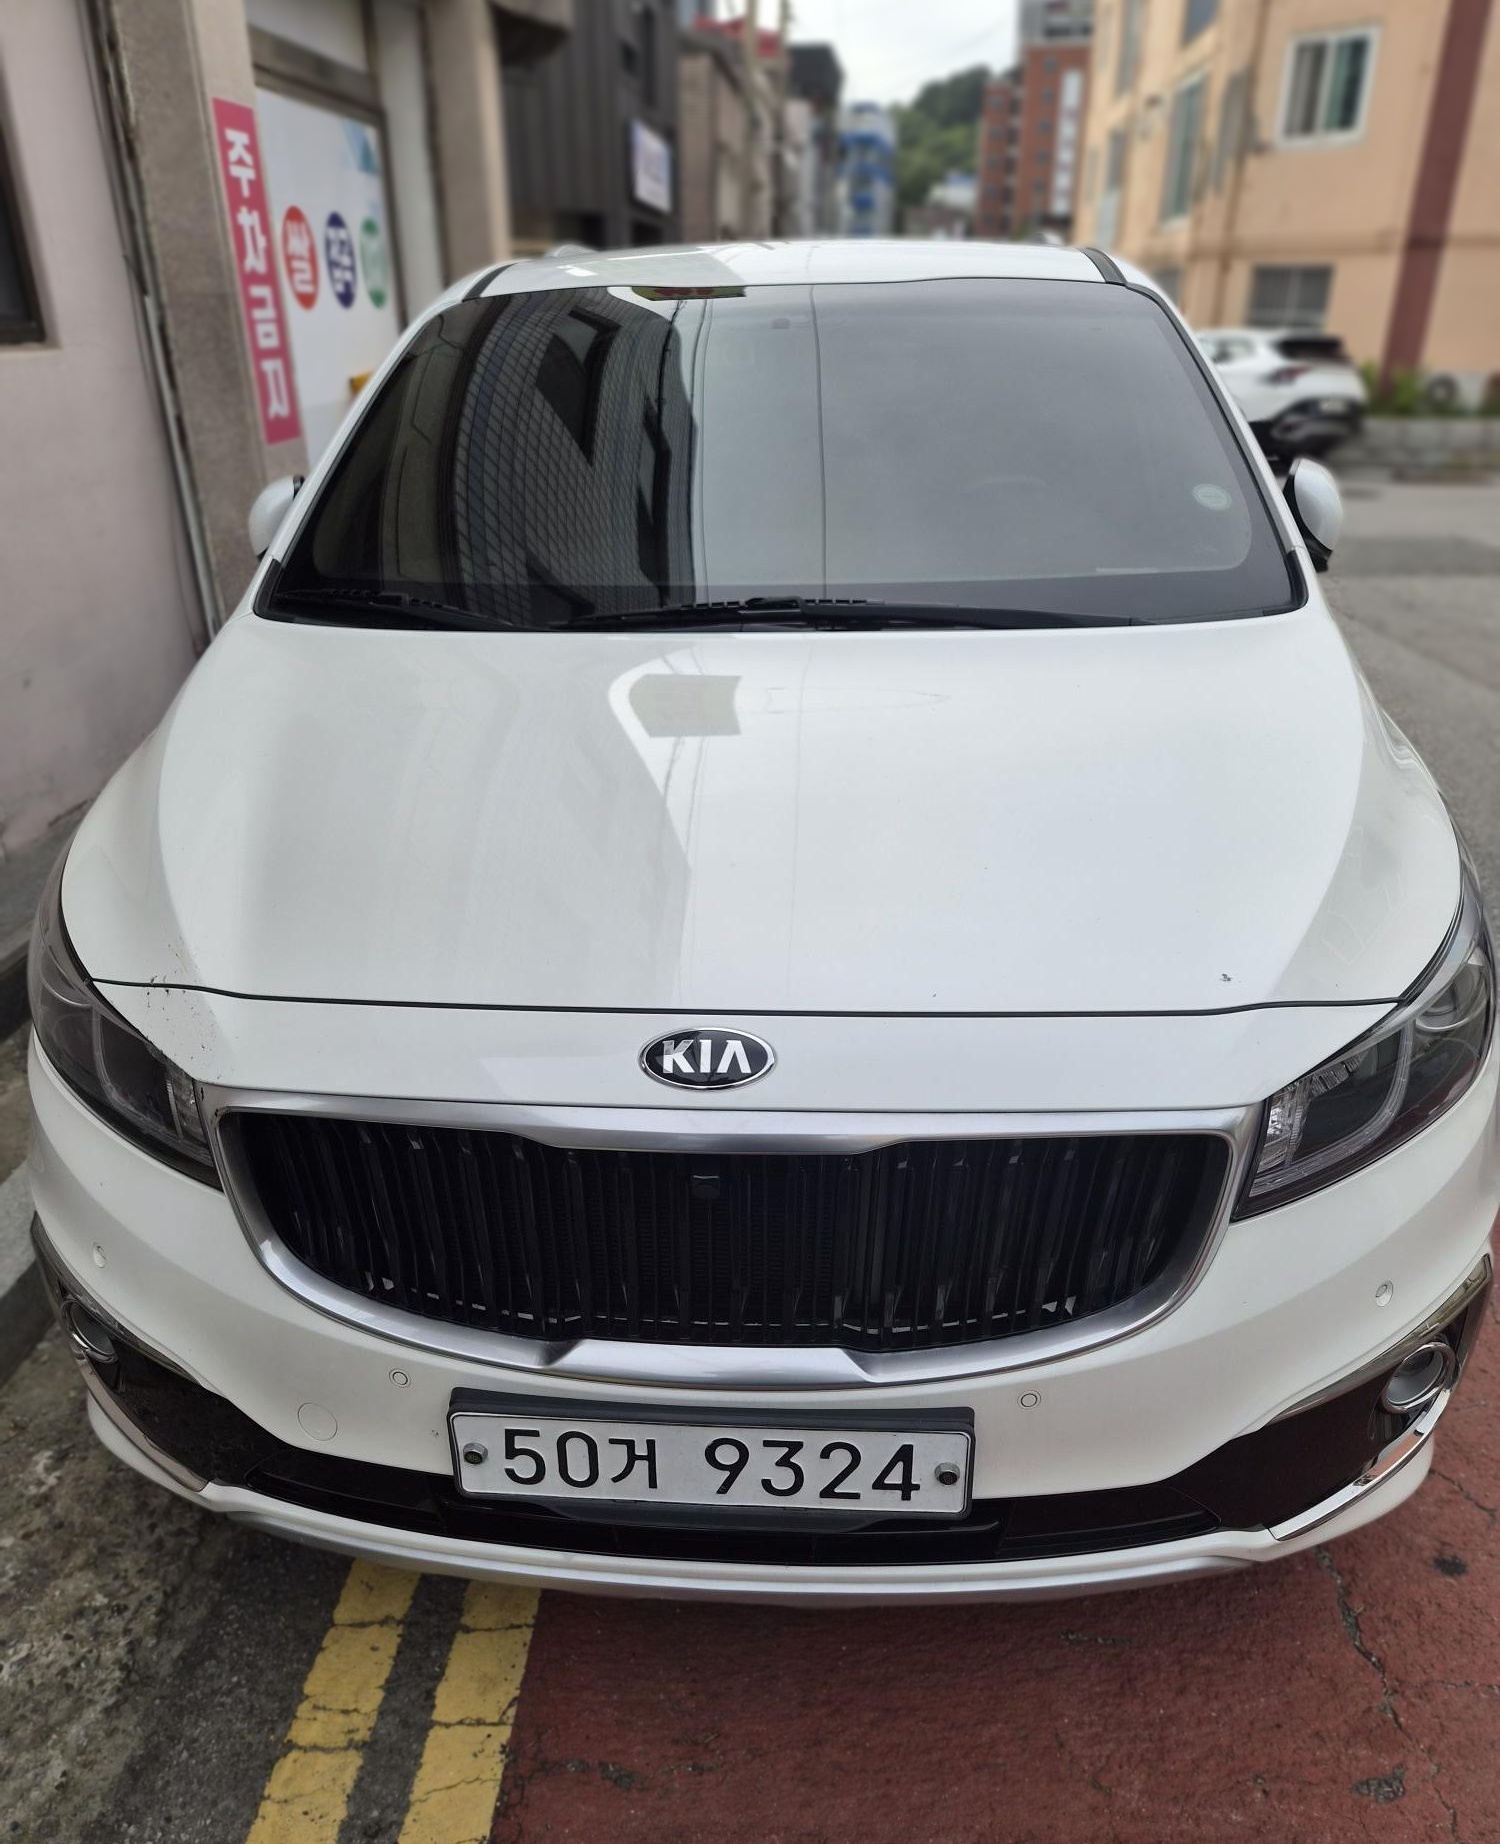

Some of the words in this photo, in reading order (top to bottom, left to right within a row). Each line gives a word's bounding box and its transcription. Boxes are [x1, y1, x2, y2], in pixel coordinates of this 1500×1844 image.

[224, 128, 290, 418] 주차금지
[662, 1039, 752, 1073] KIA
[503, 1428, 658, 1489] 50거
[703, 1437, 921, 1501] 9324
